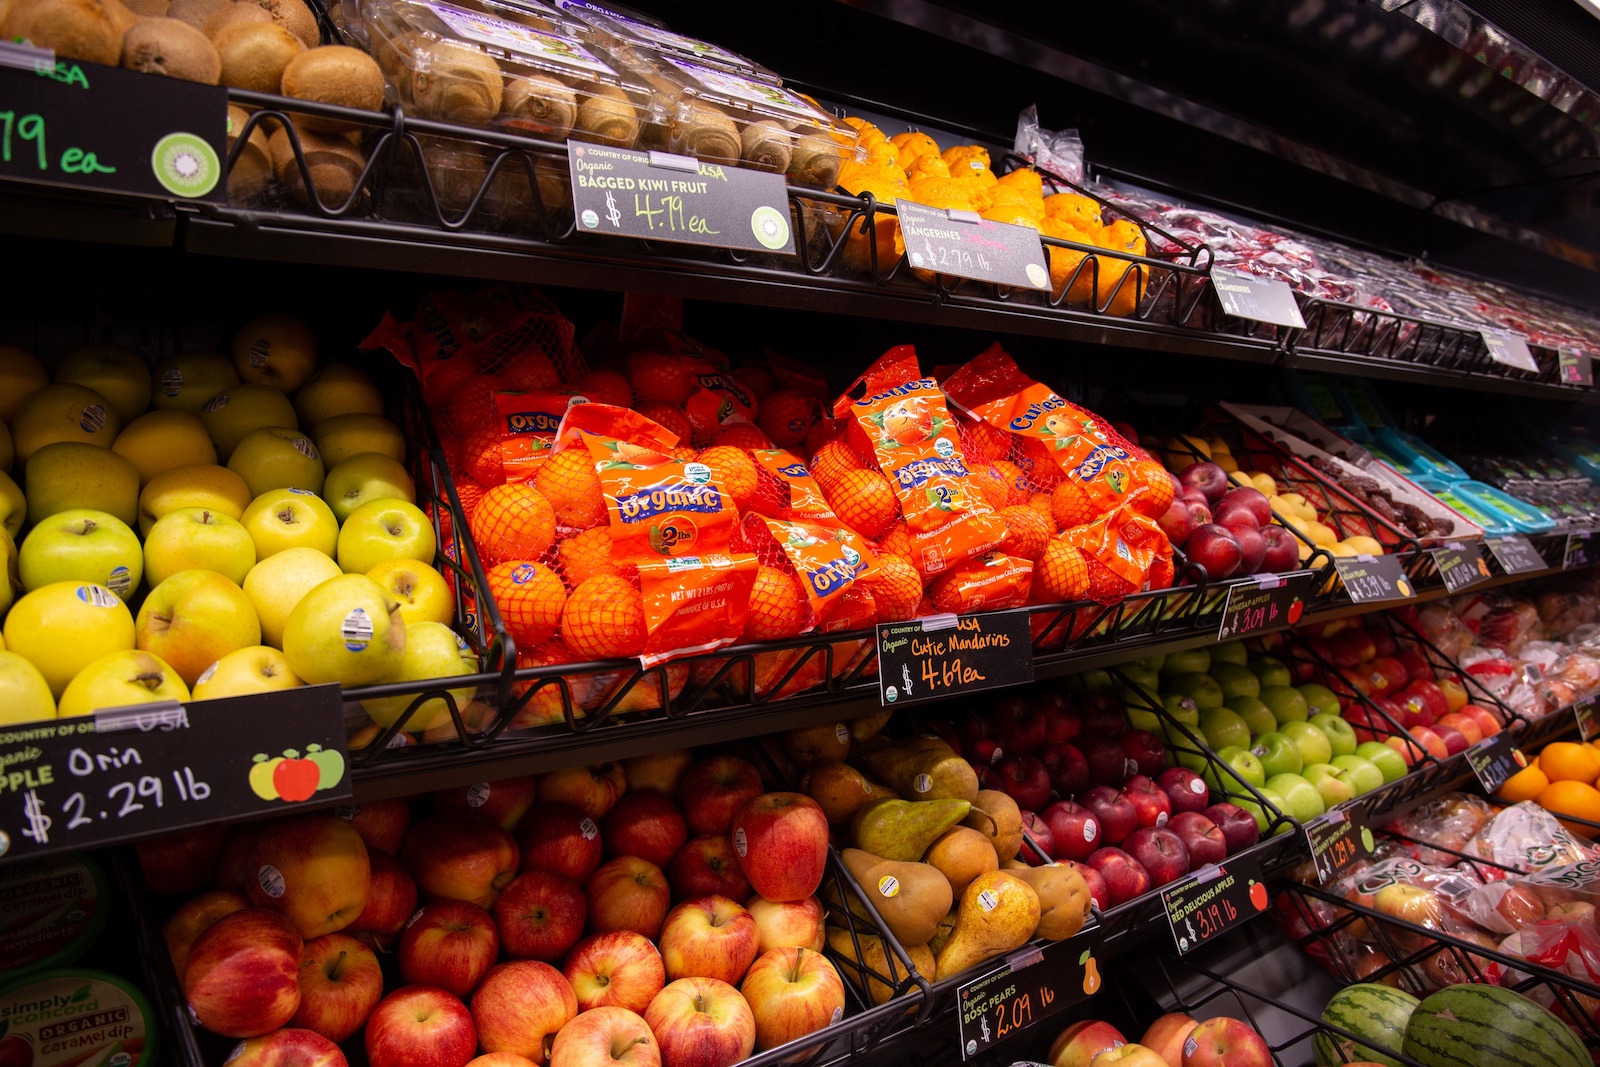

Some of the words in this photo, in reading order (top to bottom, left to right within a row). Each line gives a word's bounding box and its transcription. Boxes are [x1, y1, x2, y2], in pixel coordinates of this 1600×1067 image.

[60, 147, 117, 174] ea
[588, 148, 621, 160] COUNTRY
[621, 153, 632, 162] OF
[576, 158, 613, 175] Organic
[697, 163, 729, 182] USA
[578, 175, 636, 191] BAGGED
[638, 178, 669, 192] KIWI
[670, 180, 707, 194] FRUIT
[902, 212, 927, 226] Organic
[904, 225, 961, 241] TANGERINES
[1009, 393, 1066, 431] Cuties
[936, 486, 952, 503] 2
[661, 526, 678, 548] 2
[678, 530, 691, 541] lbs
[671, 589, 684, 603] NET
[685, 588, 697, 600] WT
[702, 586, 714, 597] LBS
[702, 601, 711, 611] OF
[890, 625, 914, 635] COUNTRY
[956, 617, 981, 633] USA
[882, 637, 909, 653] Organic
[911, 636, 947, 657] Cutie
[949, 633, 1011, 653] Mandarins
[58, 723, 76, 737] OF
[68, 747, 143, 776] Orin
[62, 775, 163, 830] 2.29
[173, 766, 211, 802] lb
[3, 874, 80, 899] ORGANIC
[1171, 909, 1186, 924] RED
[1183, 888, 1216, 915] DELICIOUS
[1215, 875, 1236, 895] APPLES
[1222, 899, 1238, 921] lb
[969, 978, 991, 993] COUNTRY
[990, 975, 998, 983] OF
[2, 995, 71, 1018] simply
[12, 999, 98, 1025] concord
[962, 991, 987, 1012] Organic
[964, 1002, 988, 1025] BOSC
[989, 984, 1017, 1009] PEARS
[995, 993, 1033, 1039] 2.09
[1040, 986, 1055, 1008] lb
[41, 1010, 125, 1039] ORGANIC
[108, 1025, 133, 1040] dip
